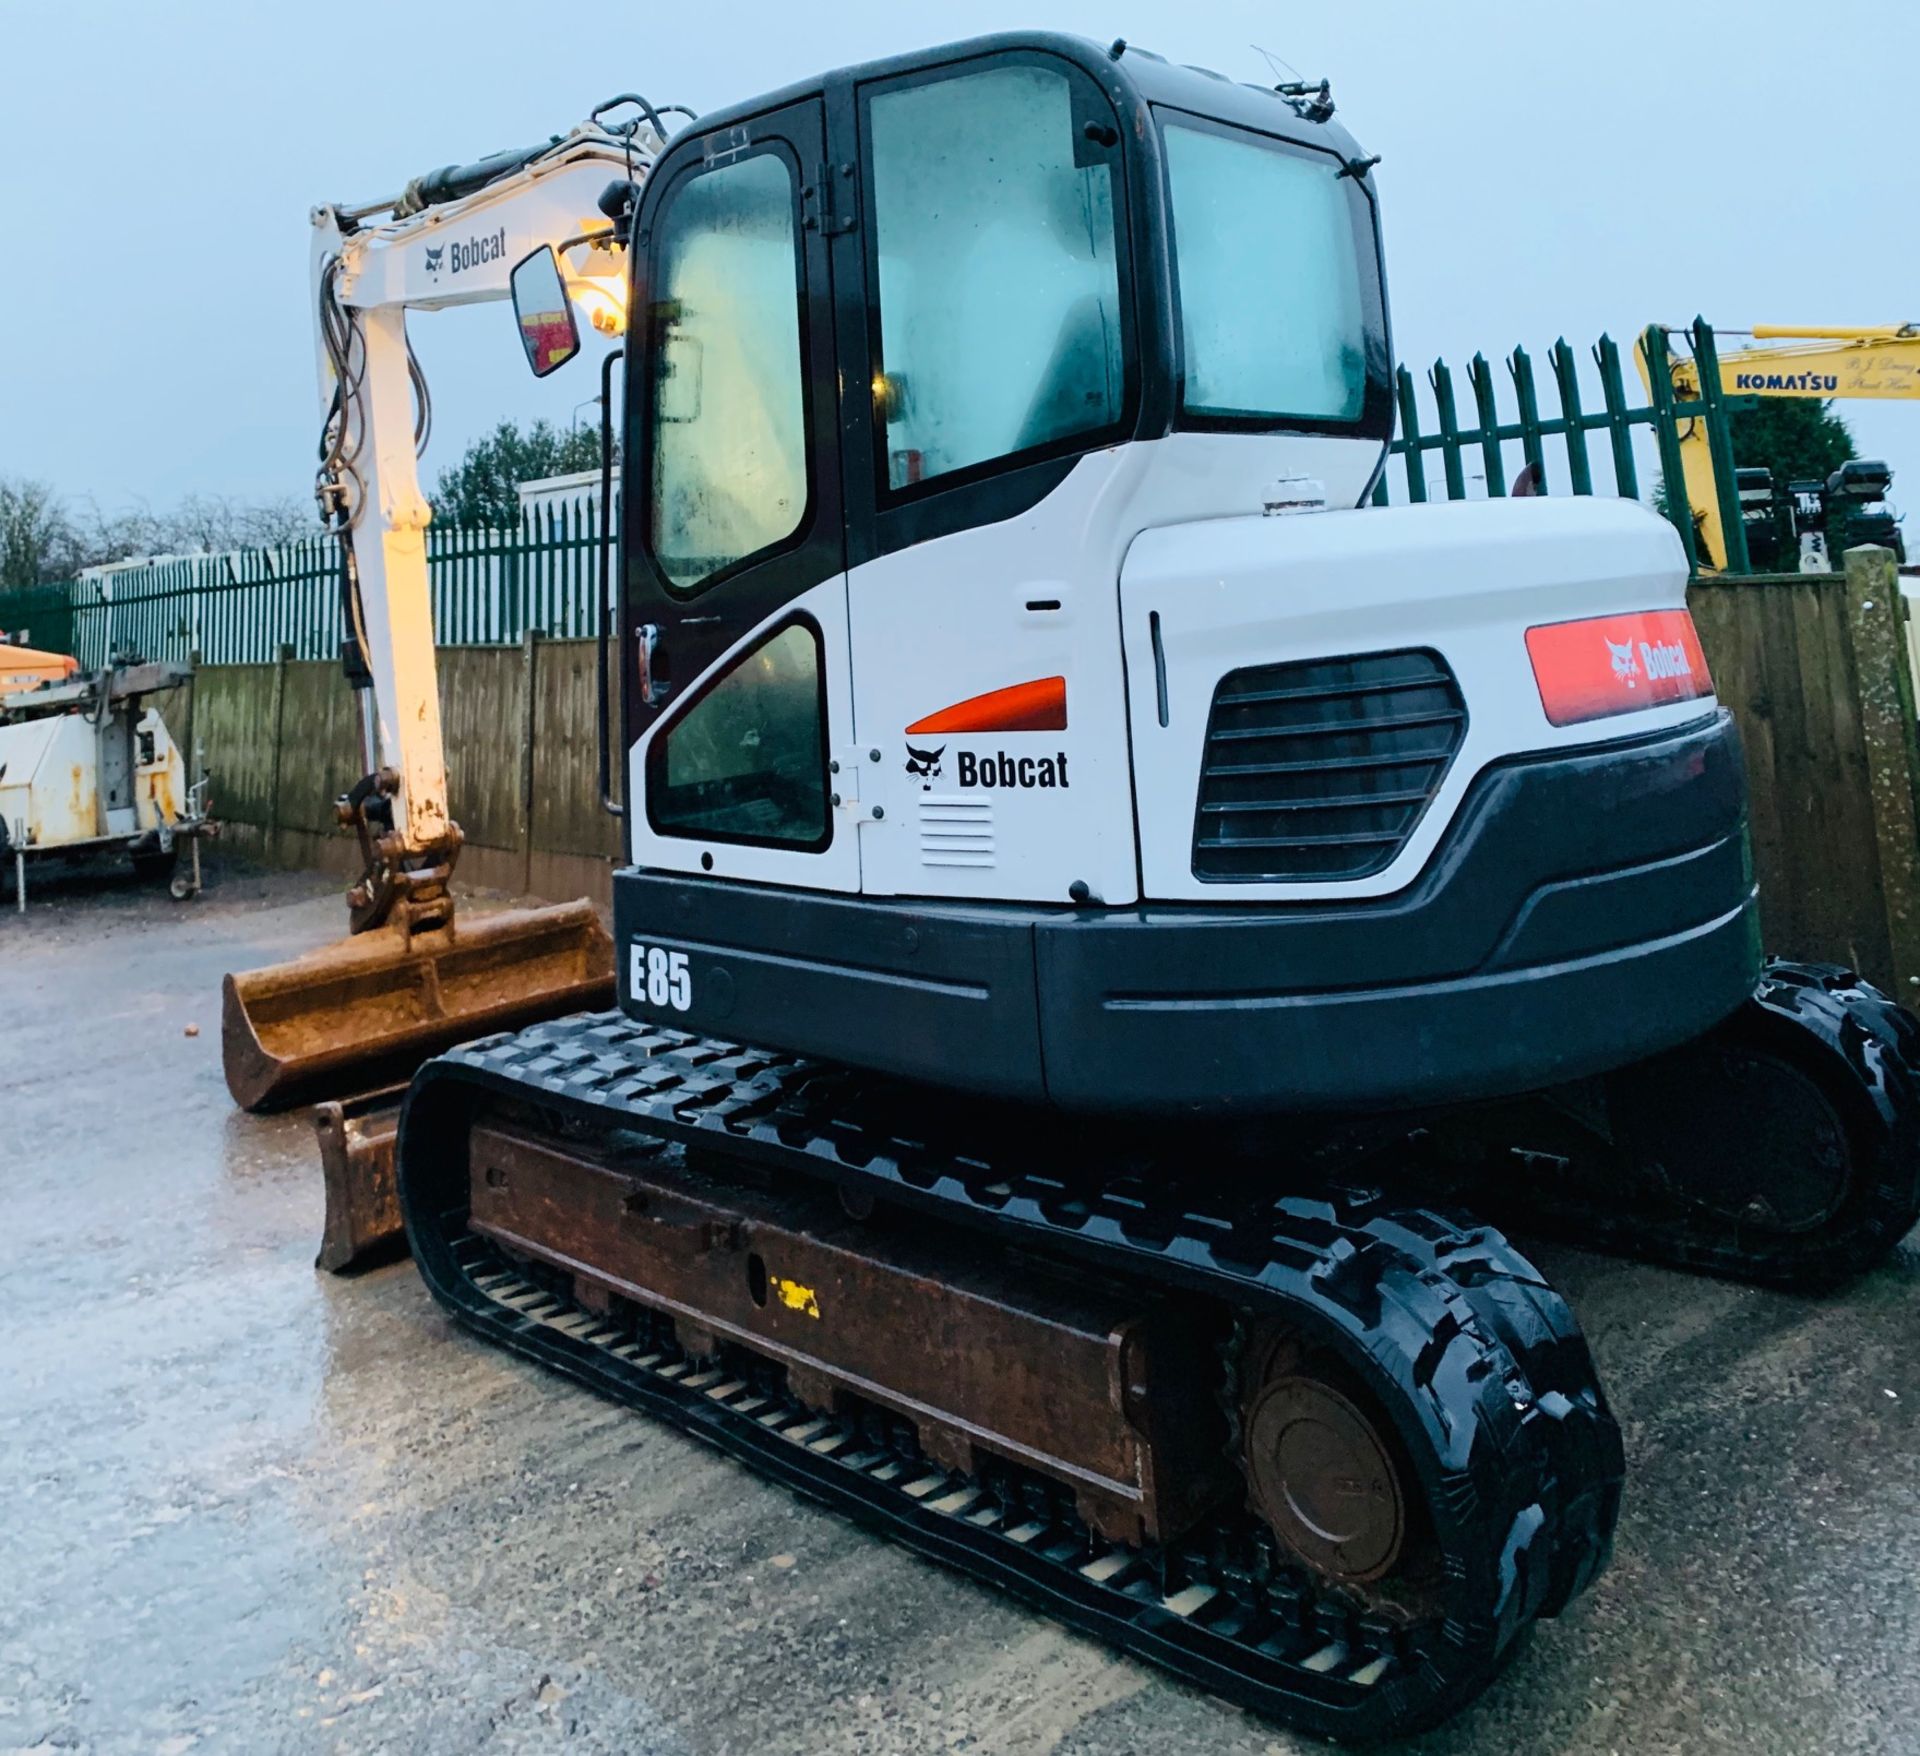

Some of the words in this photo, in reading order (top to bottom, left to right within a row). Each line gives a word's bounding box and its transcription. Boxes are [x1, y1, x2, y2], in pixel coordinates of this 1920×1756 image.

[451, 226, 506, 274] Bobcat
[1736, 370, 1838, 391] KOMATSU
[1638, 638, 1693, 681] Bobcat
[957, 750, 1070, 788] Bobcat
[630, 943, 692, 1011] E85
